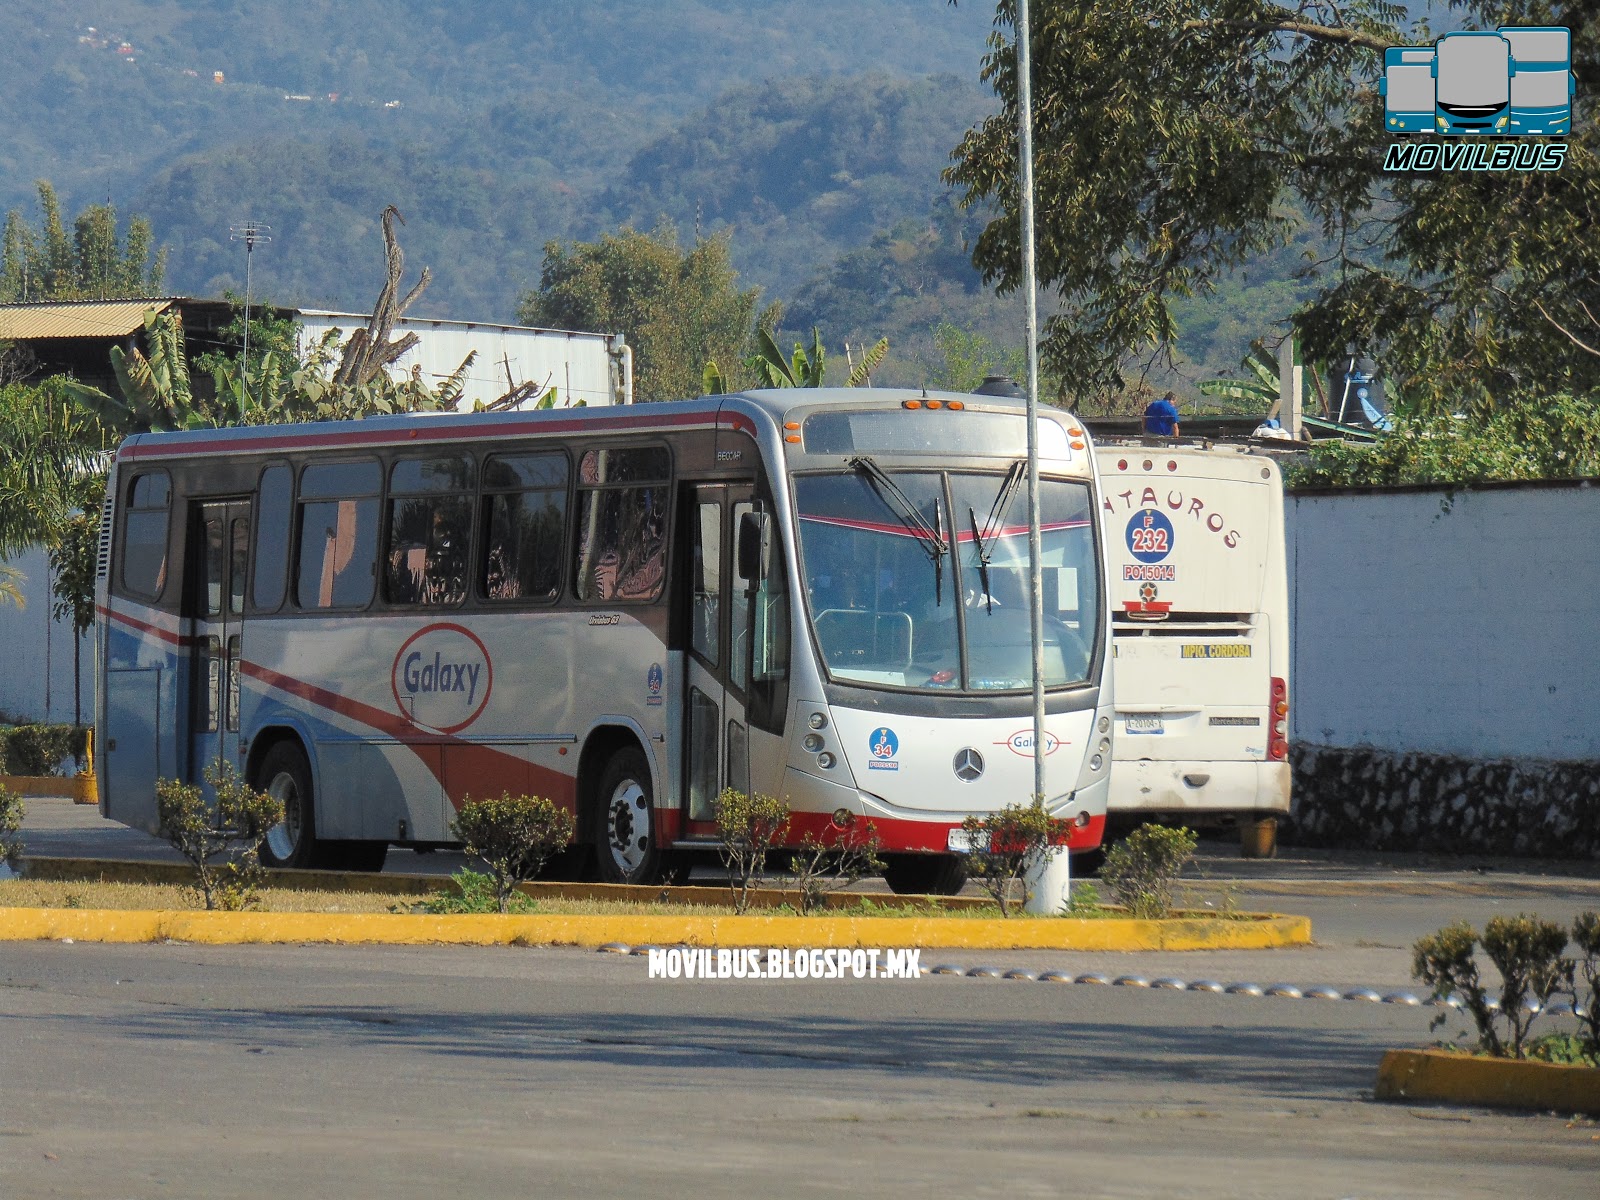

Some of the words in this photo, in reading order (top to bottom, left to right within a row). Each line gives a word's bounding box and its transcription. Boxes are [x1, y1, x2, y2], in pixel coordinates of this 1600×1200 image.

[1143, 516, 1153, 528] F
[1132, 528, 1168, 552] 232
[1208, 644, 1251, 658] CORDOBA
[403, 651, 481, 706] Galaxy
[874, 744, 893, 757] 34
